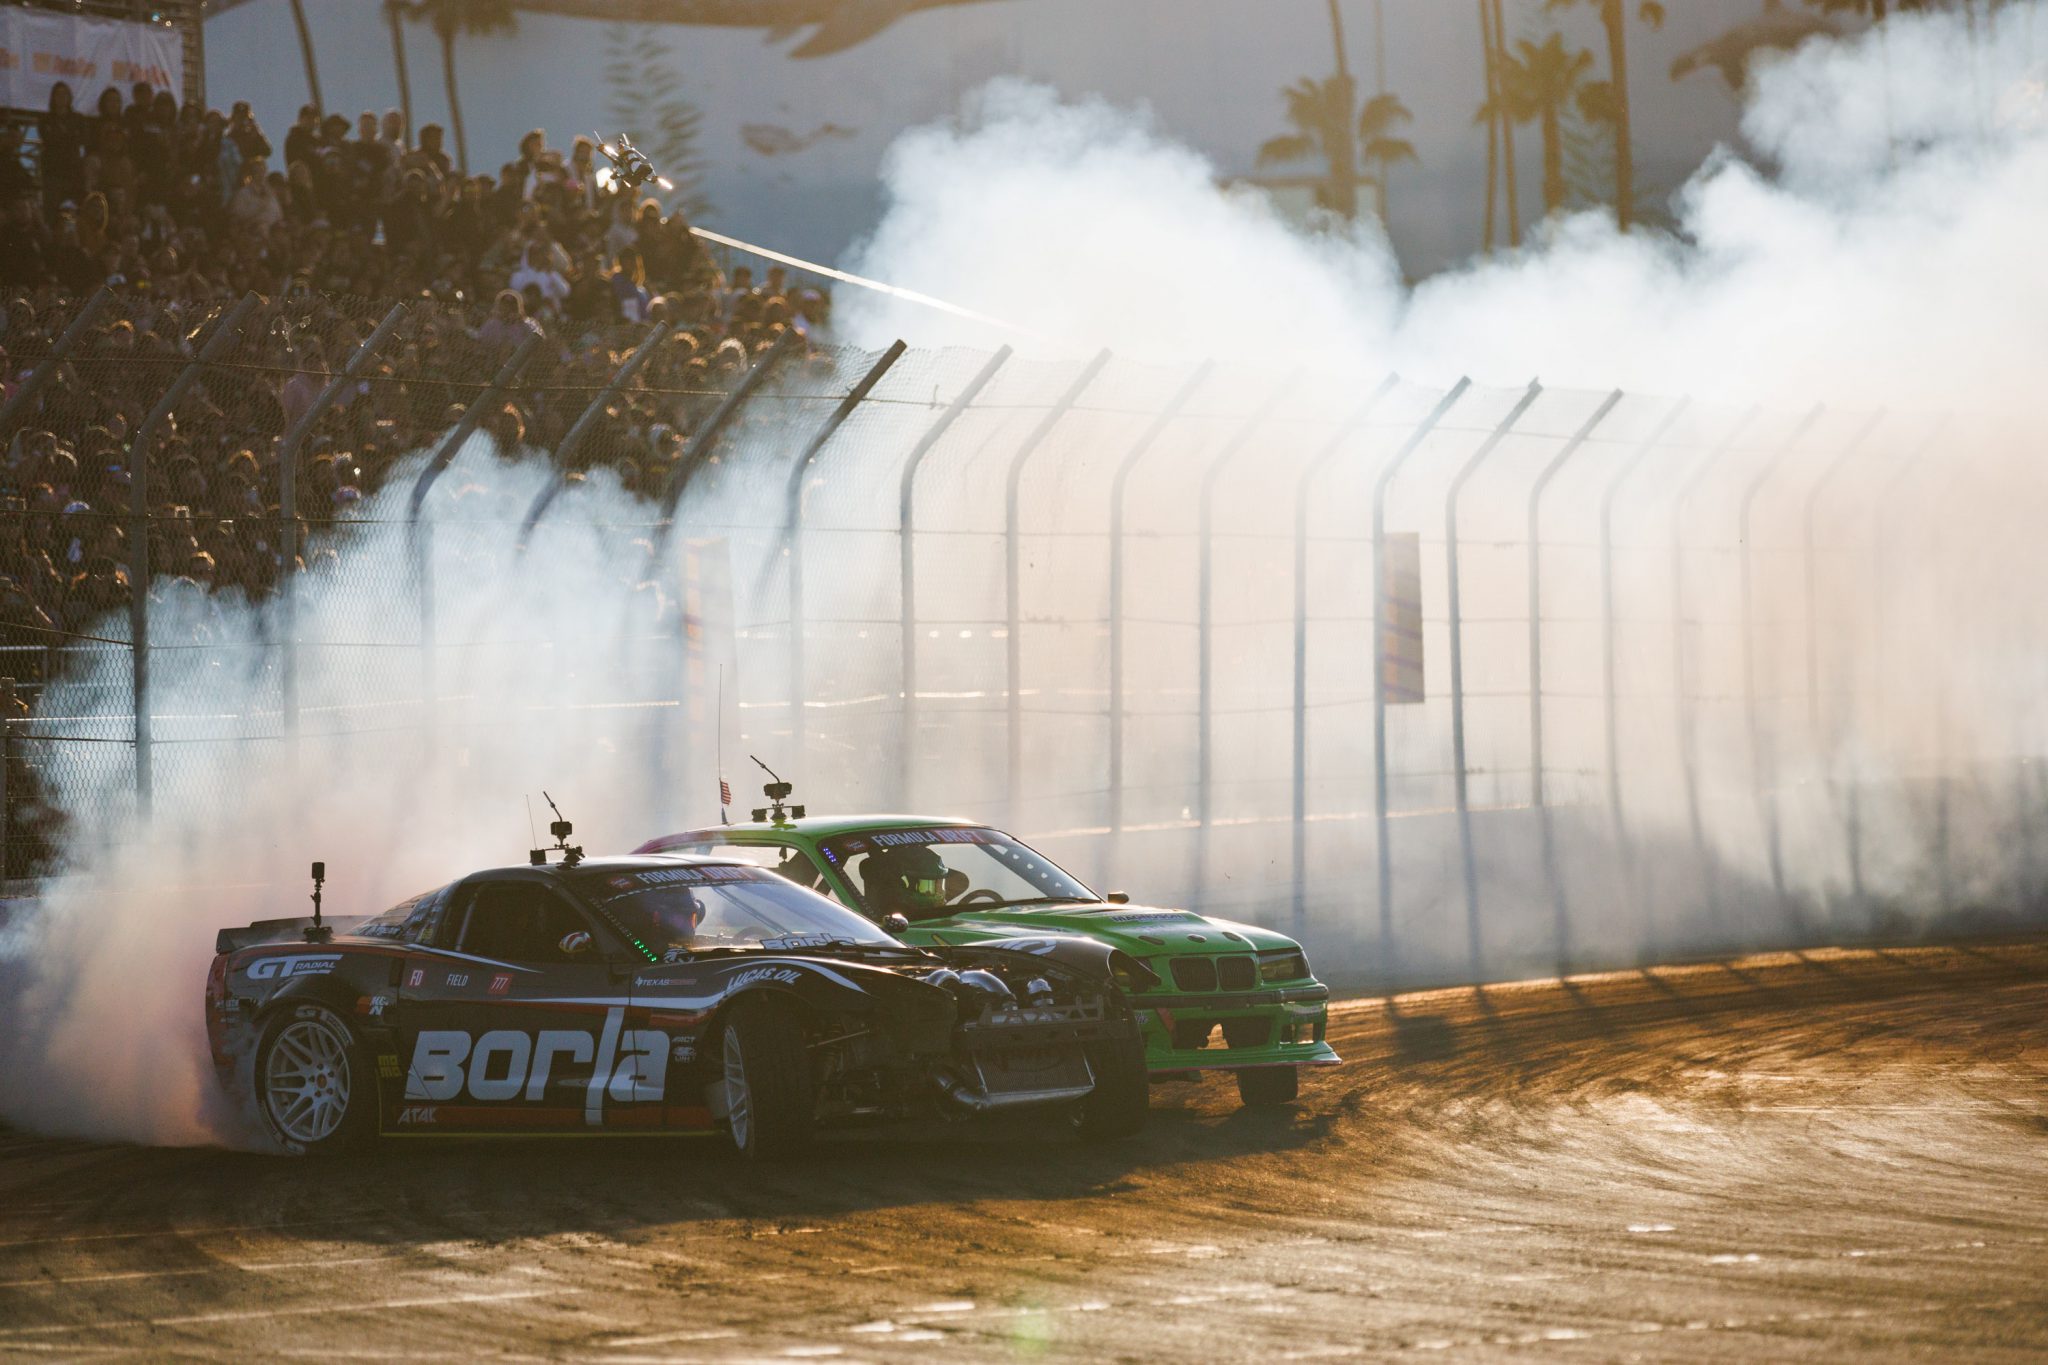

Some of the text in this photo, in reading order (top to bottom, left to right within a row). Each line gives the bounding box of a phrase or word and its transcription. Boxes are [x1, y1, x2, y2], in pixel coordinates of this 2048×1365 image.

[871, 831, 939, 847] FORMULA
[935, 829, 986, 844] DRIFT
[635, 868, 704, 885] FORMULA
[246, 954, 344, 980] GT RADIAL
[409, 969, 424, 986] FD
[446, 973, 469, 987] FIELD
[490, 976, 509, 991] 777
[726, 967, 803, 993] LUCAS OIL
[397, 1107, 438, 1126] ATAK
